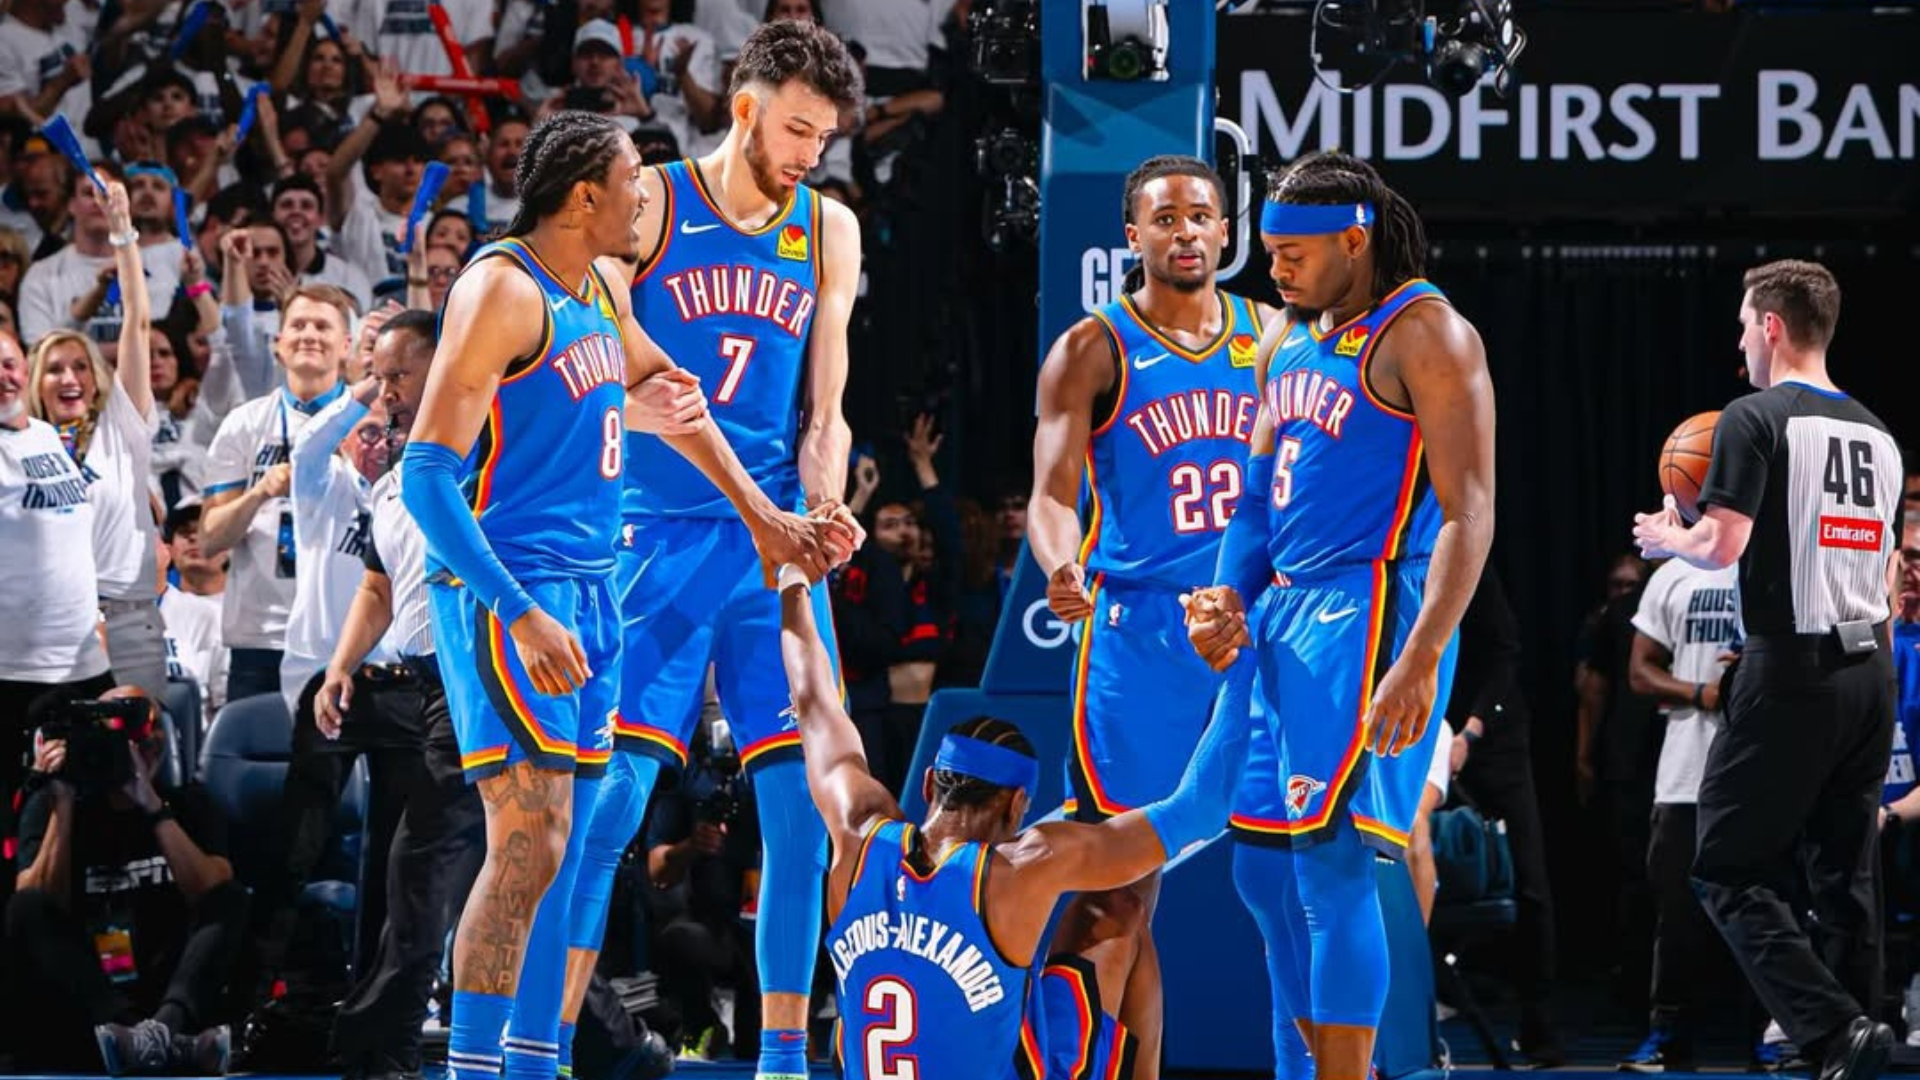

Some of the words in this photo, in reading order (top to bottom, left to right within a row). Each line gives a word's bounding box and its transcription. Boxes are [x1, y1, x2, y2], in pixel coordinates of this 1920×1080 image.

[1240, 70, 1720, 160] MIDFIRST
[664, 265, 814, 339] THUNDER
[712, 333, 757, 404] 7
[599, 406, 623, 481] 8
[1125, 389, 1257, 459] THUNDE
[1168, 458, 1243, 536] 22
[1271, 435, 1302, 510] 5
[1823, 436, 1876, 507] 46
[1823, 523, 1878, 544] Emirates
[862, 973, 919, 1080] 2
